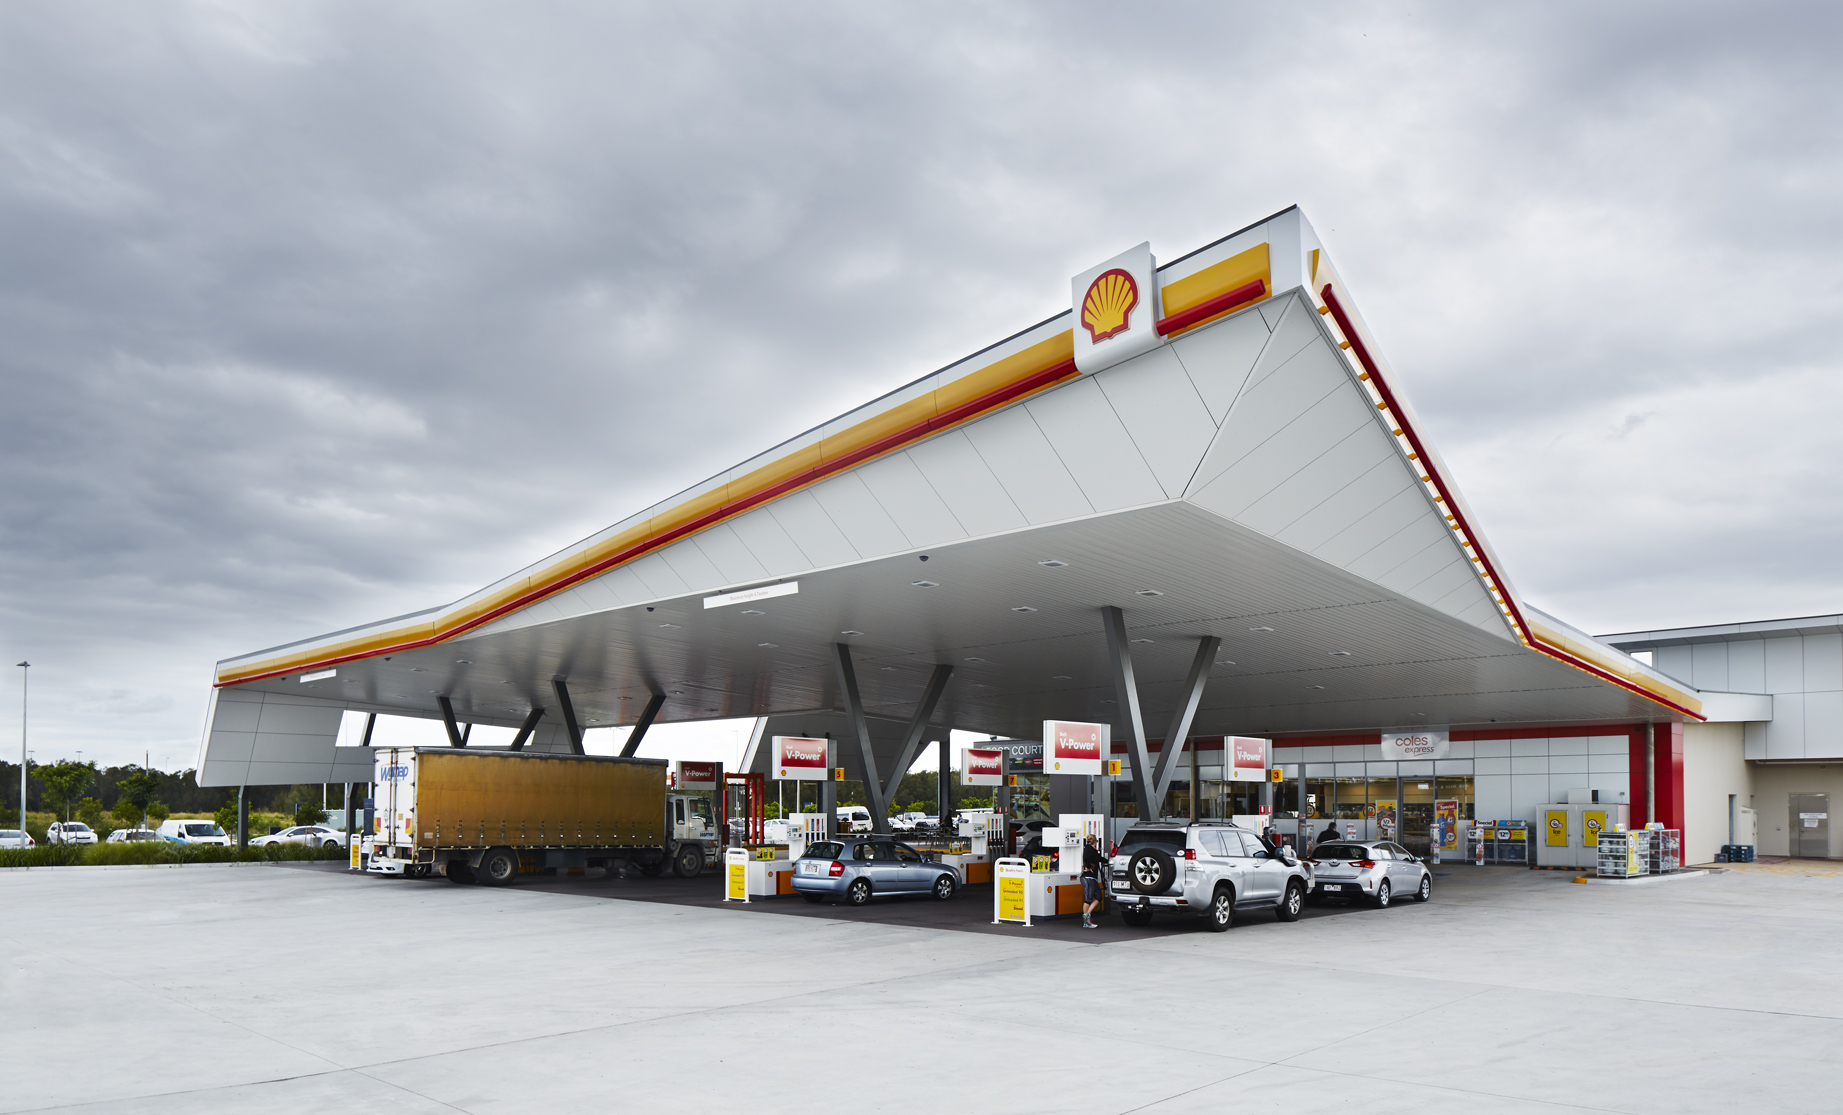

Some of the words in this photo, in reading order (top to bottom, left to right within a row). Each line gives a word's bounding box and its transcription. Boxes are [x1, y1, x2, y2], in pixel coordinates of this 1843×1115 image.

[1059, 738, 1095, 751] V-Power
[1395, 735, 1428, 747] coles
[785, 750, 821, 761] V-Power
[1011, 745, 1043, 756] COURT
[1236, 750, 1261, 761] V-Power
[1404, 746, 1435, 755] express
[971, 760, 998, 769] V-Power
[1111, 763, 1116, 771] 1
[1273, 771, 1280, 780] 3
